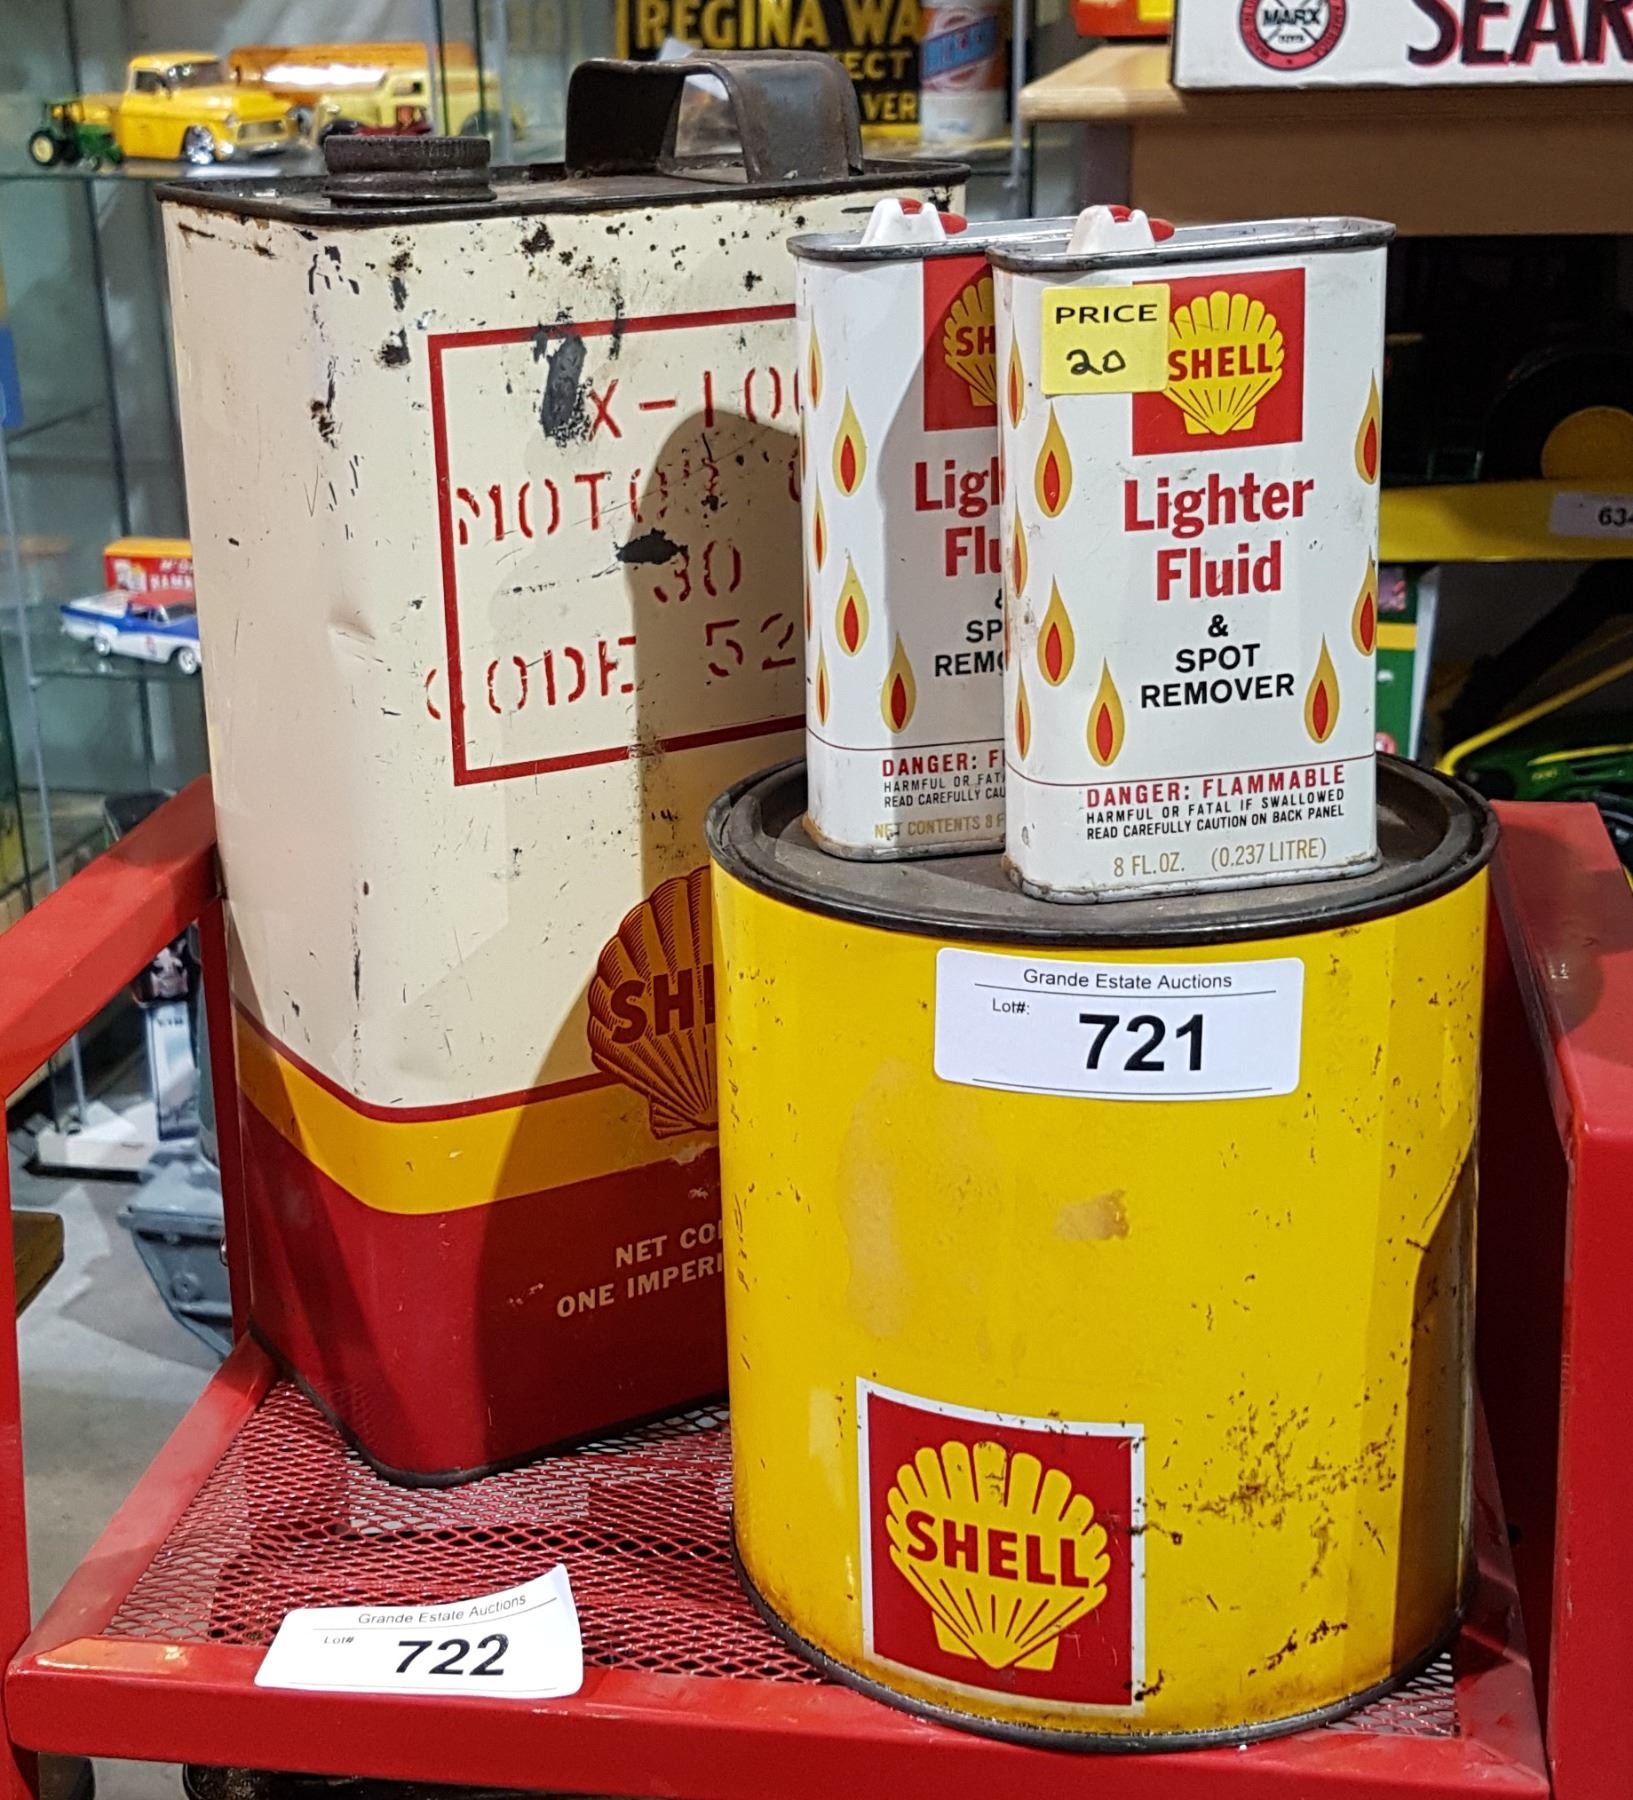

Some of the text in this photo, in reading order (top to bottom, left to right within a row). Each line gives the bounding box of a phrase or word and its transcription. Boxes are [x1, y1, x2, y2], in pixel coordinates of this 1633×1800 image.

[637, 0, 830, 49] REGINA
[1263, 9, 1320, 25] MARX
[833, 52, 912, 80] ECT
[1055, 303, 1158, 324] PRICE
[1066, 348, 1127, 376] 20
[1168, 343, 1273, 382] SHELL
[588, 367, 800, 442] X-10
[1124, 472, 1315, 539] Lighter
[1157, 540, 1281, 601] Fluid
[1208, 614, 1229, 638] &
[425, 612, 797, 721] CODE 52
[935, 650, 1004, 678] REM
[1175, 643, 1261, 674] SPOT
[1141, 673, 1295, 709] REMOVER
[882, 749, 1005, 778] DANGER: F
[883, 777, 946, 793] HARMFUL
[953, 775, 970, 788] OR
[884, 794, 914, 808] READ
[918, 788, 981, 806] CAREFULLY
[1086, 764, 1346, 808] DANGER: FLAMMABLE
[1086, 787, 1345, 825] HARMFUL OR FATAL IF SWALLOWED
[1086, 803, 1346, 841] READ CAREFULLY CAUTION ON BACK PANEL
[907, 815, 980, 836] CONTENTS
[1113, 856, 1124, 878] 8
[1211, 840, 1266, 871] (0.237
[1269, 837, 1327, 863] LITRE)
[1023, 968, 1233, 990] Grande Estate Auctions
[991, 997, 1031, 1016] Lot#:
[1079, 1013, 1204, 1072] 721
[615, 1235, 667, 1268] NET
[557, 1283, 615, 1318] ONE
[905, 1510, 1089, 1588] SHELL
[358, 1594, 527, 1625] Grande Estate Auctions
[395, 1633, 509, 1676] 722
